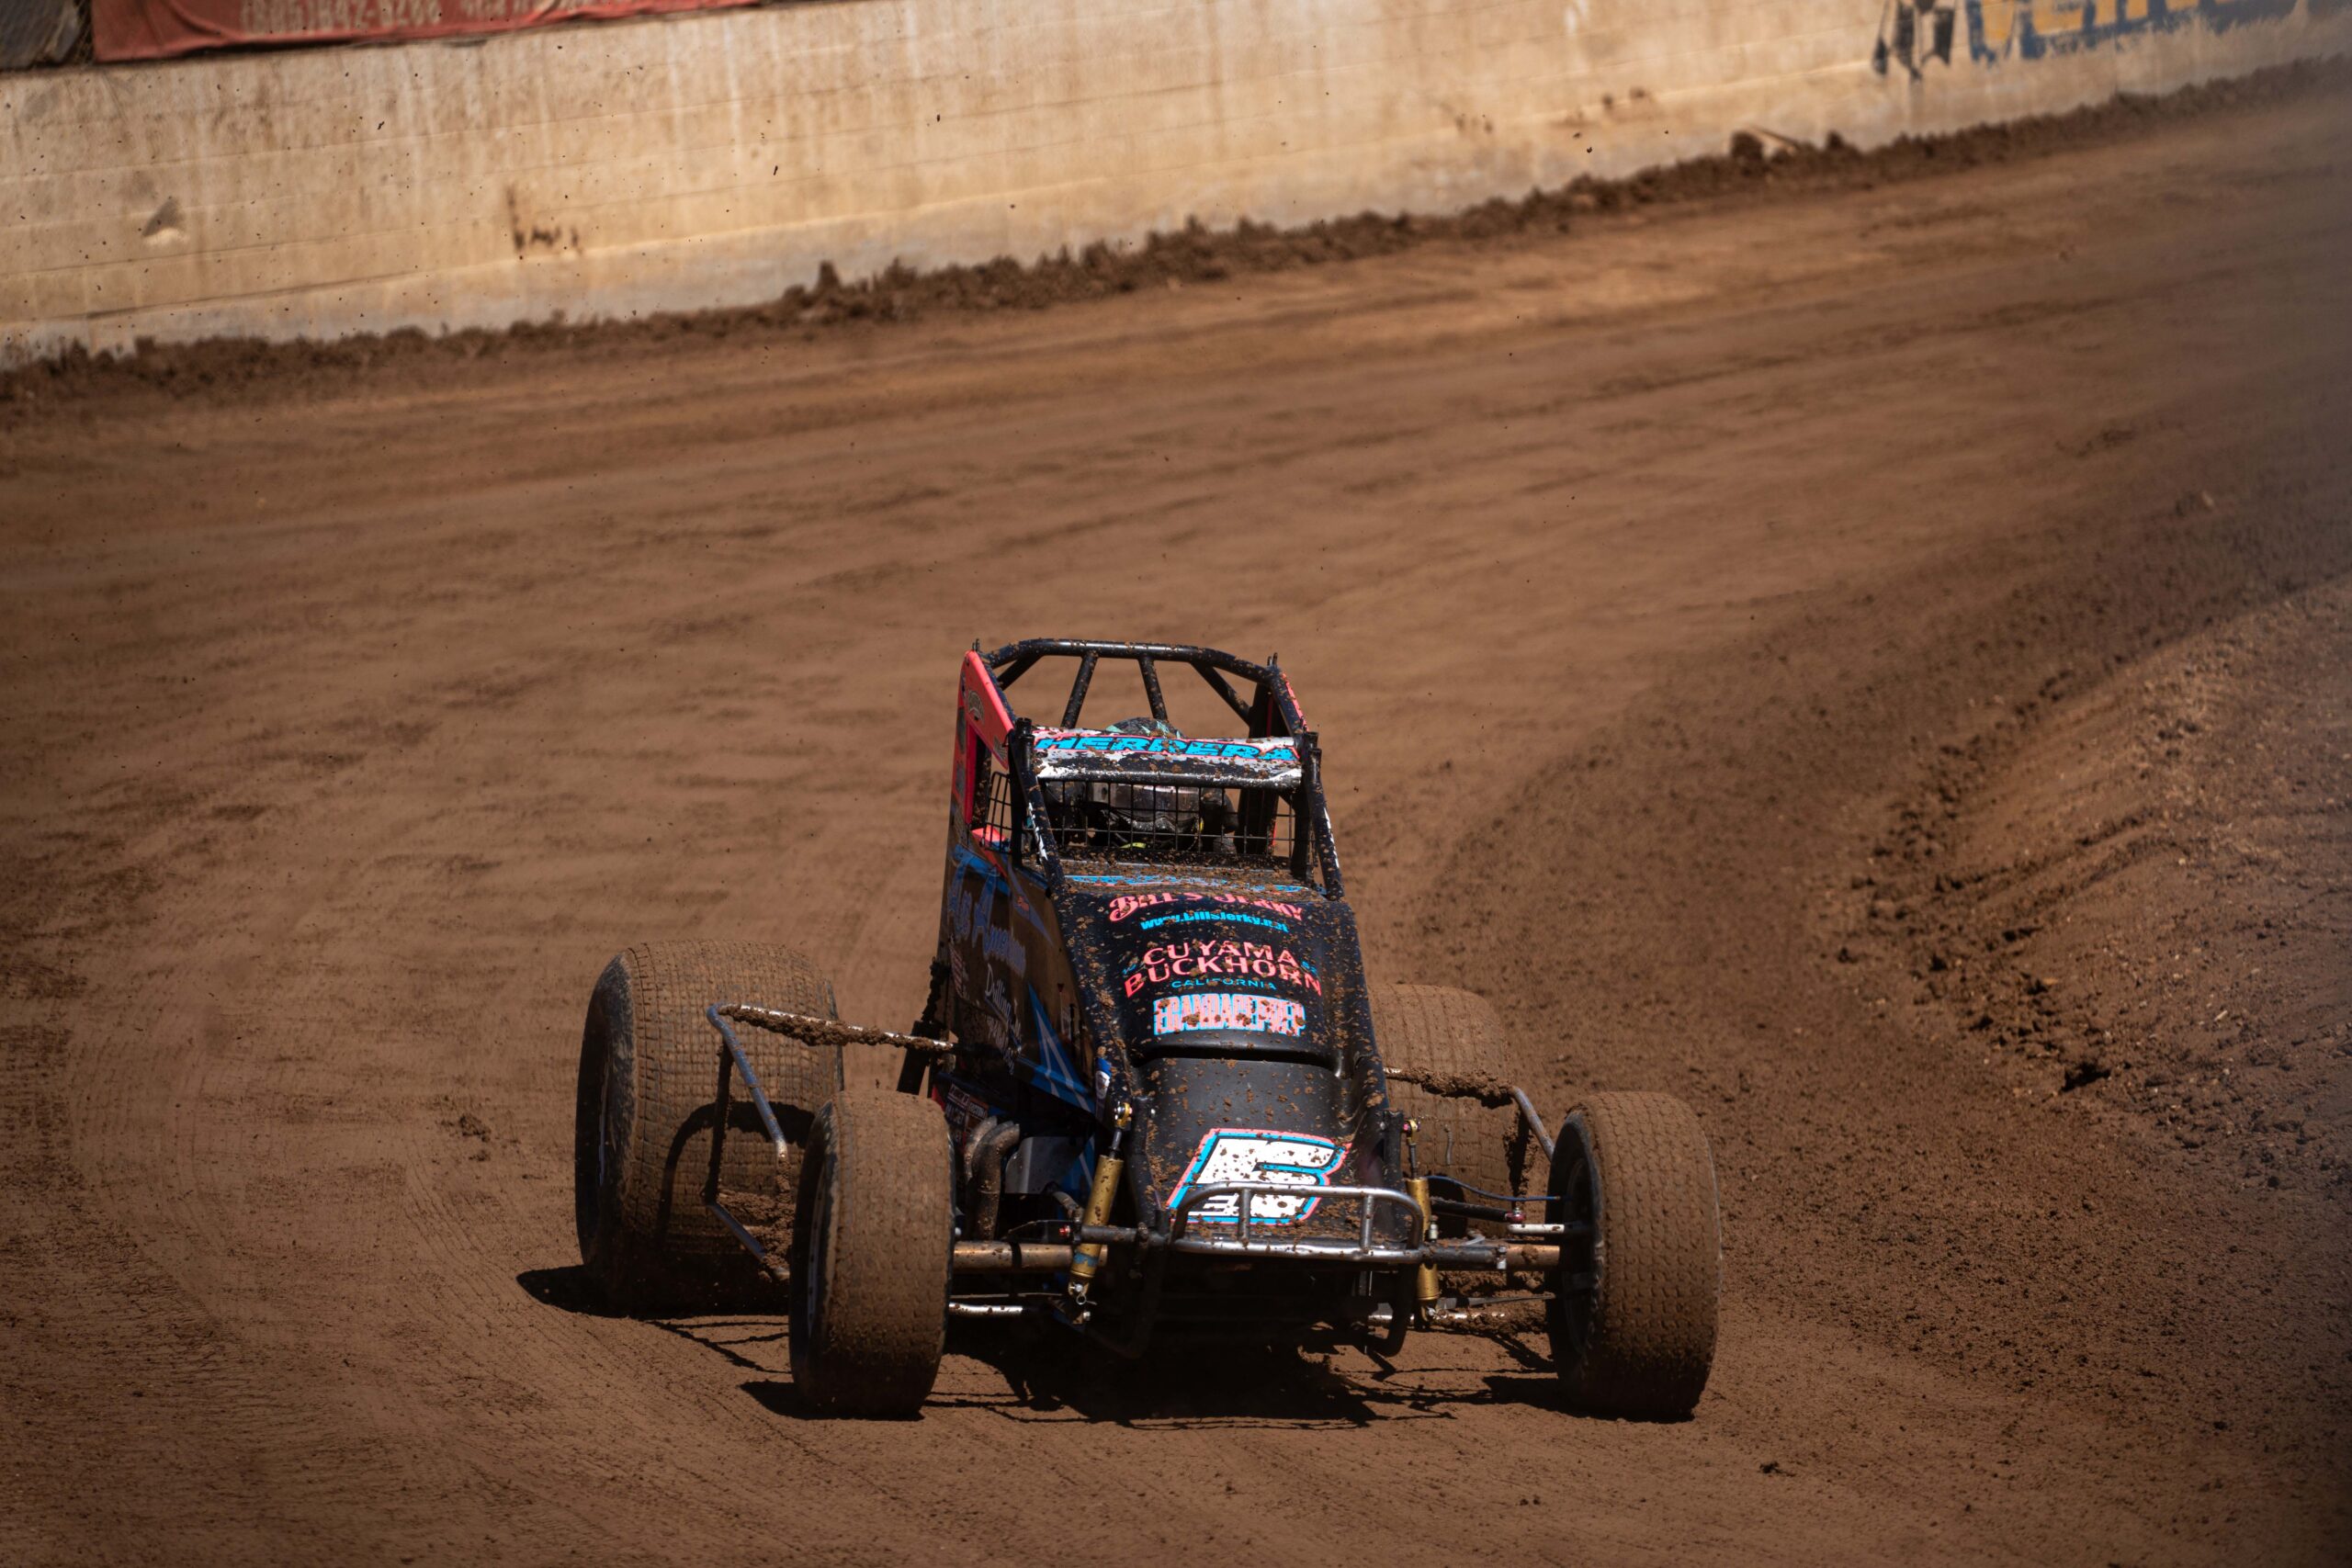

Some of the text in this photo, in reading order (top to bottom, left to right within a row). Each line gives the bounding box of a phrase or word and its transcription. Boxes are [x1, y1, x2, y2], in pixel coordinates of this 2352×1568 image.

[1035, 735, 1300, 761] HERRERA
[1144, 940, 1300, 968] CUYAMA
[1125, 955, 1322, 998] BUCKHORN
